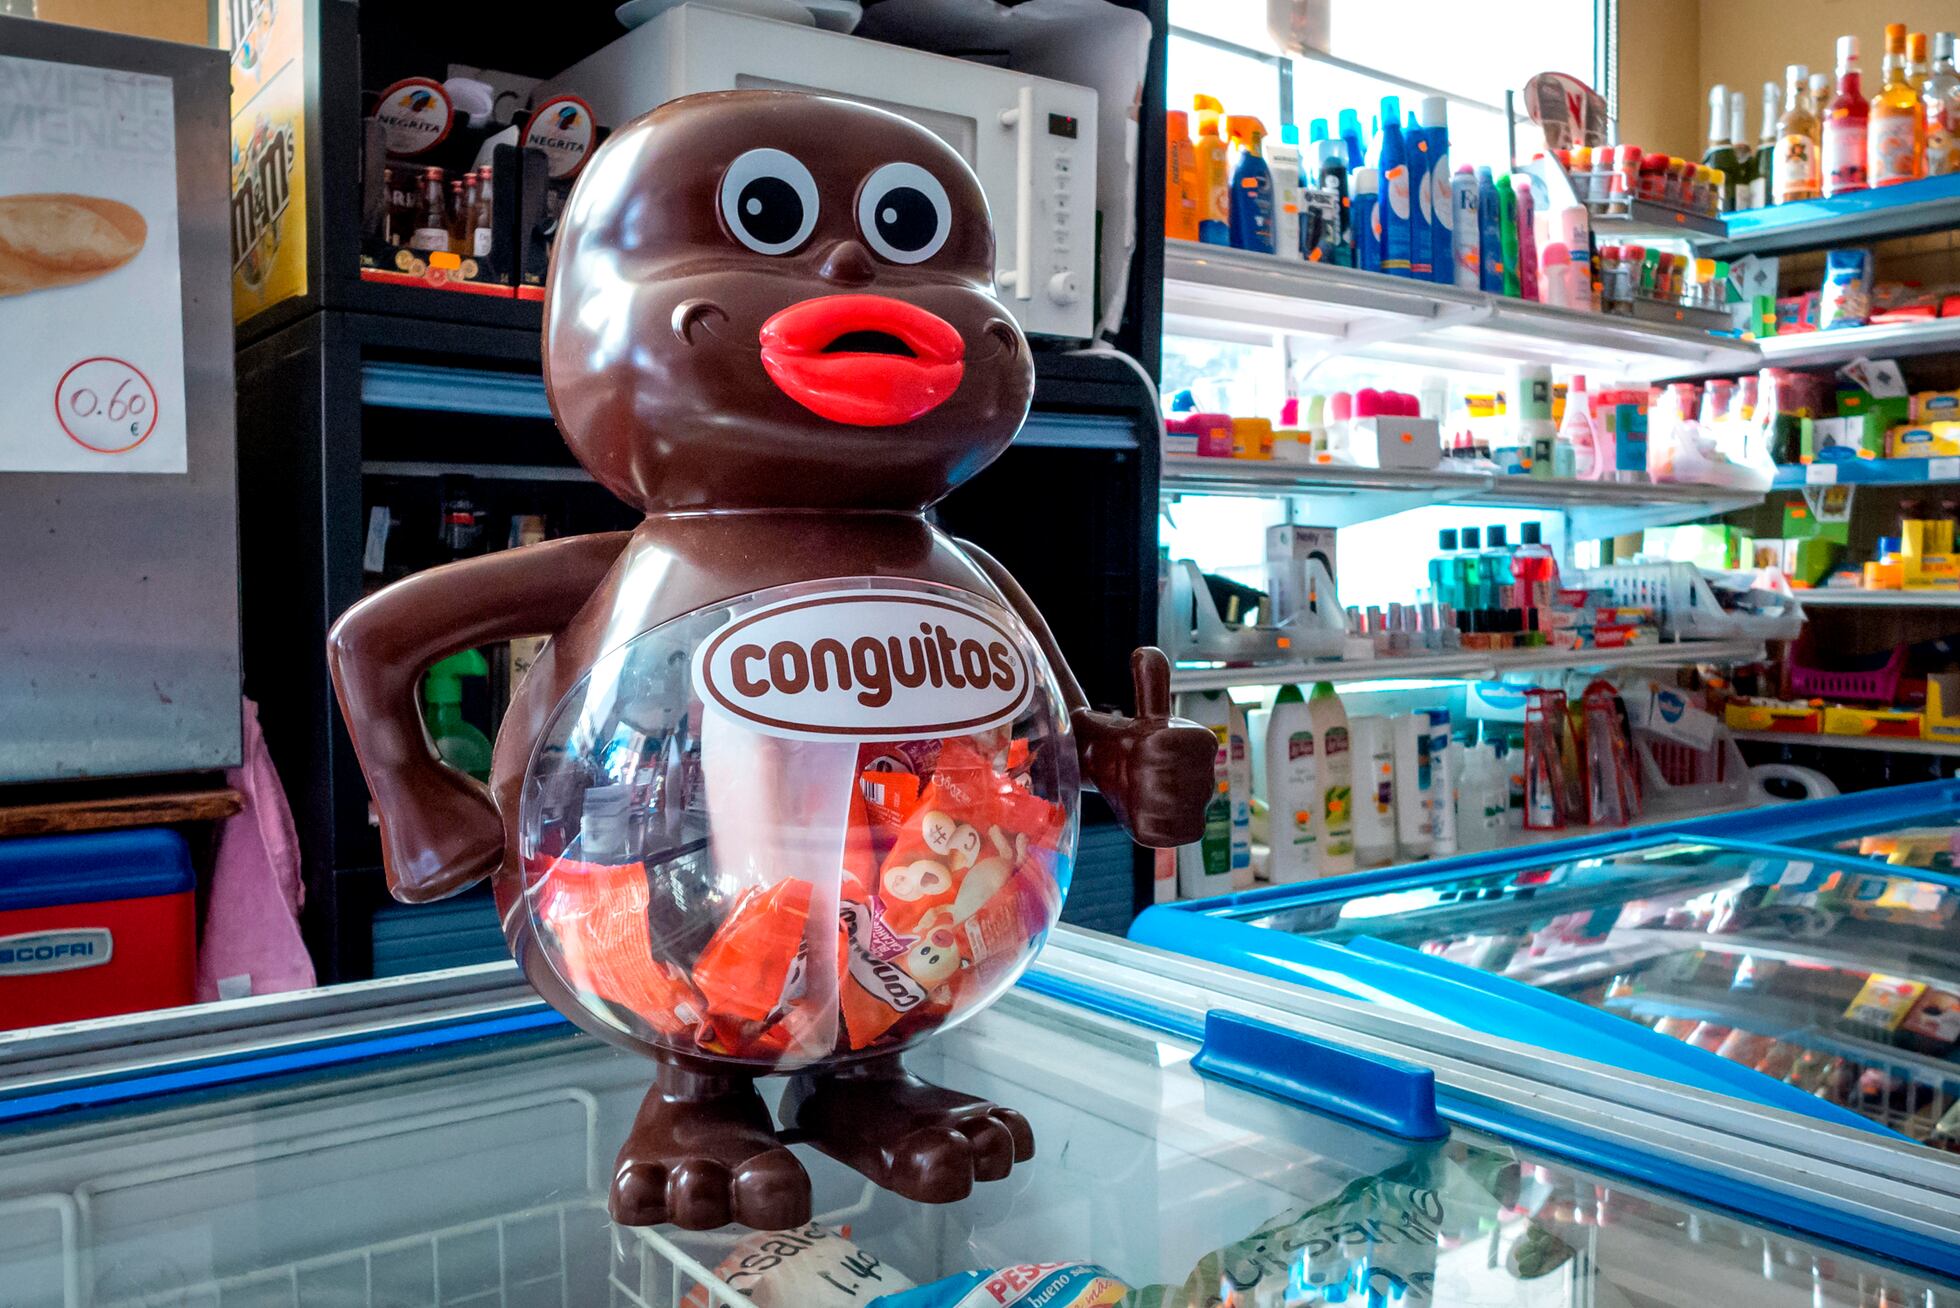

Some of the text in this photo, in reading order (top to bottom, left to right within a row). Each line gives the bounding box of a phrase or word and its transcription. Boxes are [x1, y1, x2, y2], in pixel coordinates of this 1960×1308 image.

[529, 134, 585, 153] NEGRITA
[70, 379, 146, 421] 0.60
[730, 622, 1016, 708] conguitos
[1027, 1274, 1070, 1308] bueno
